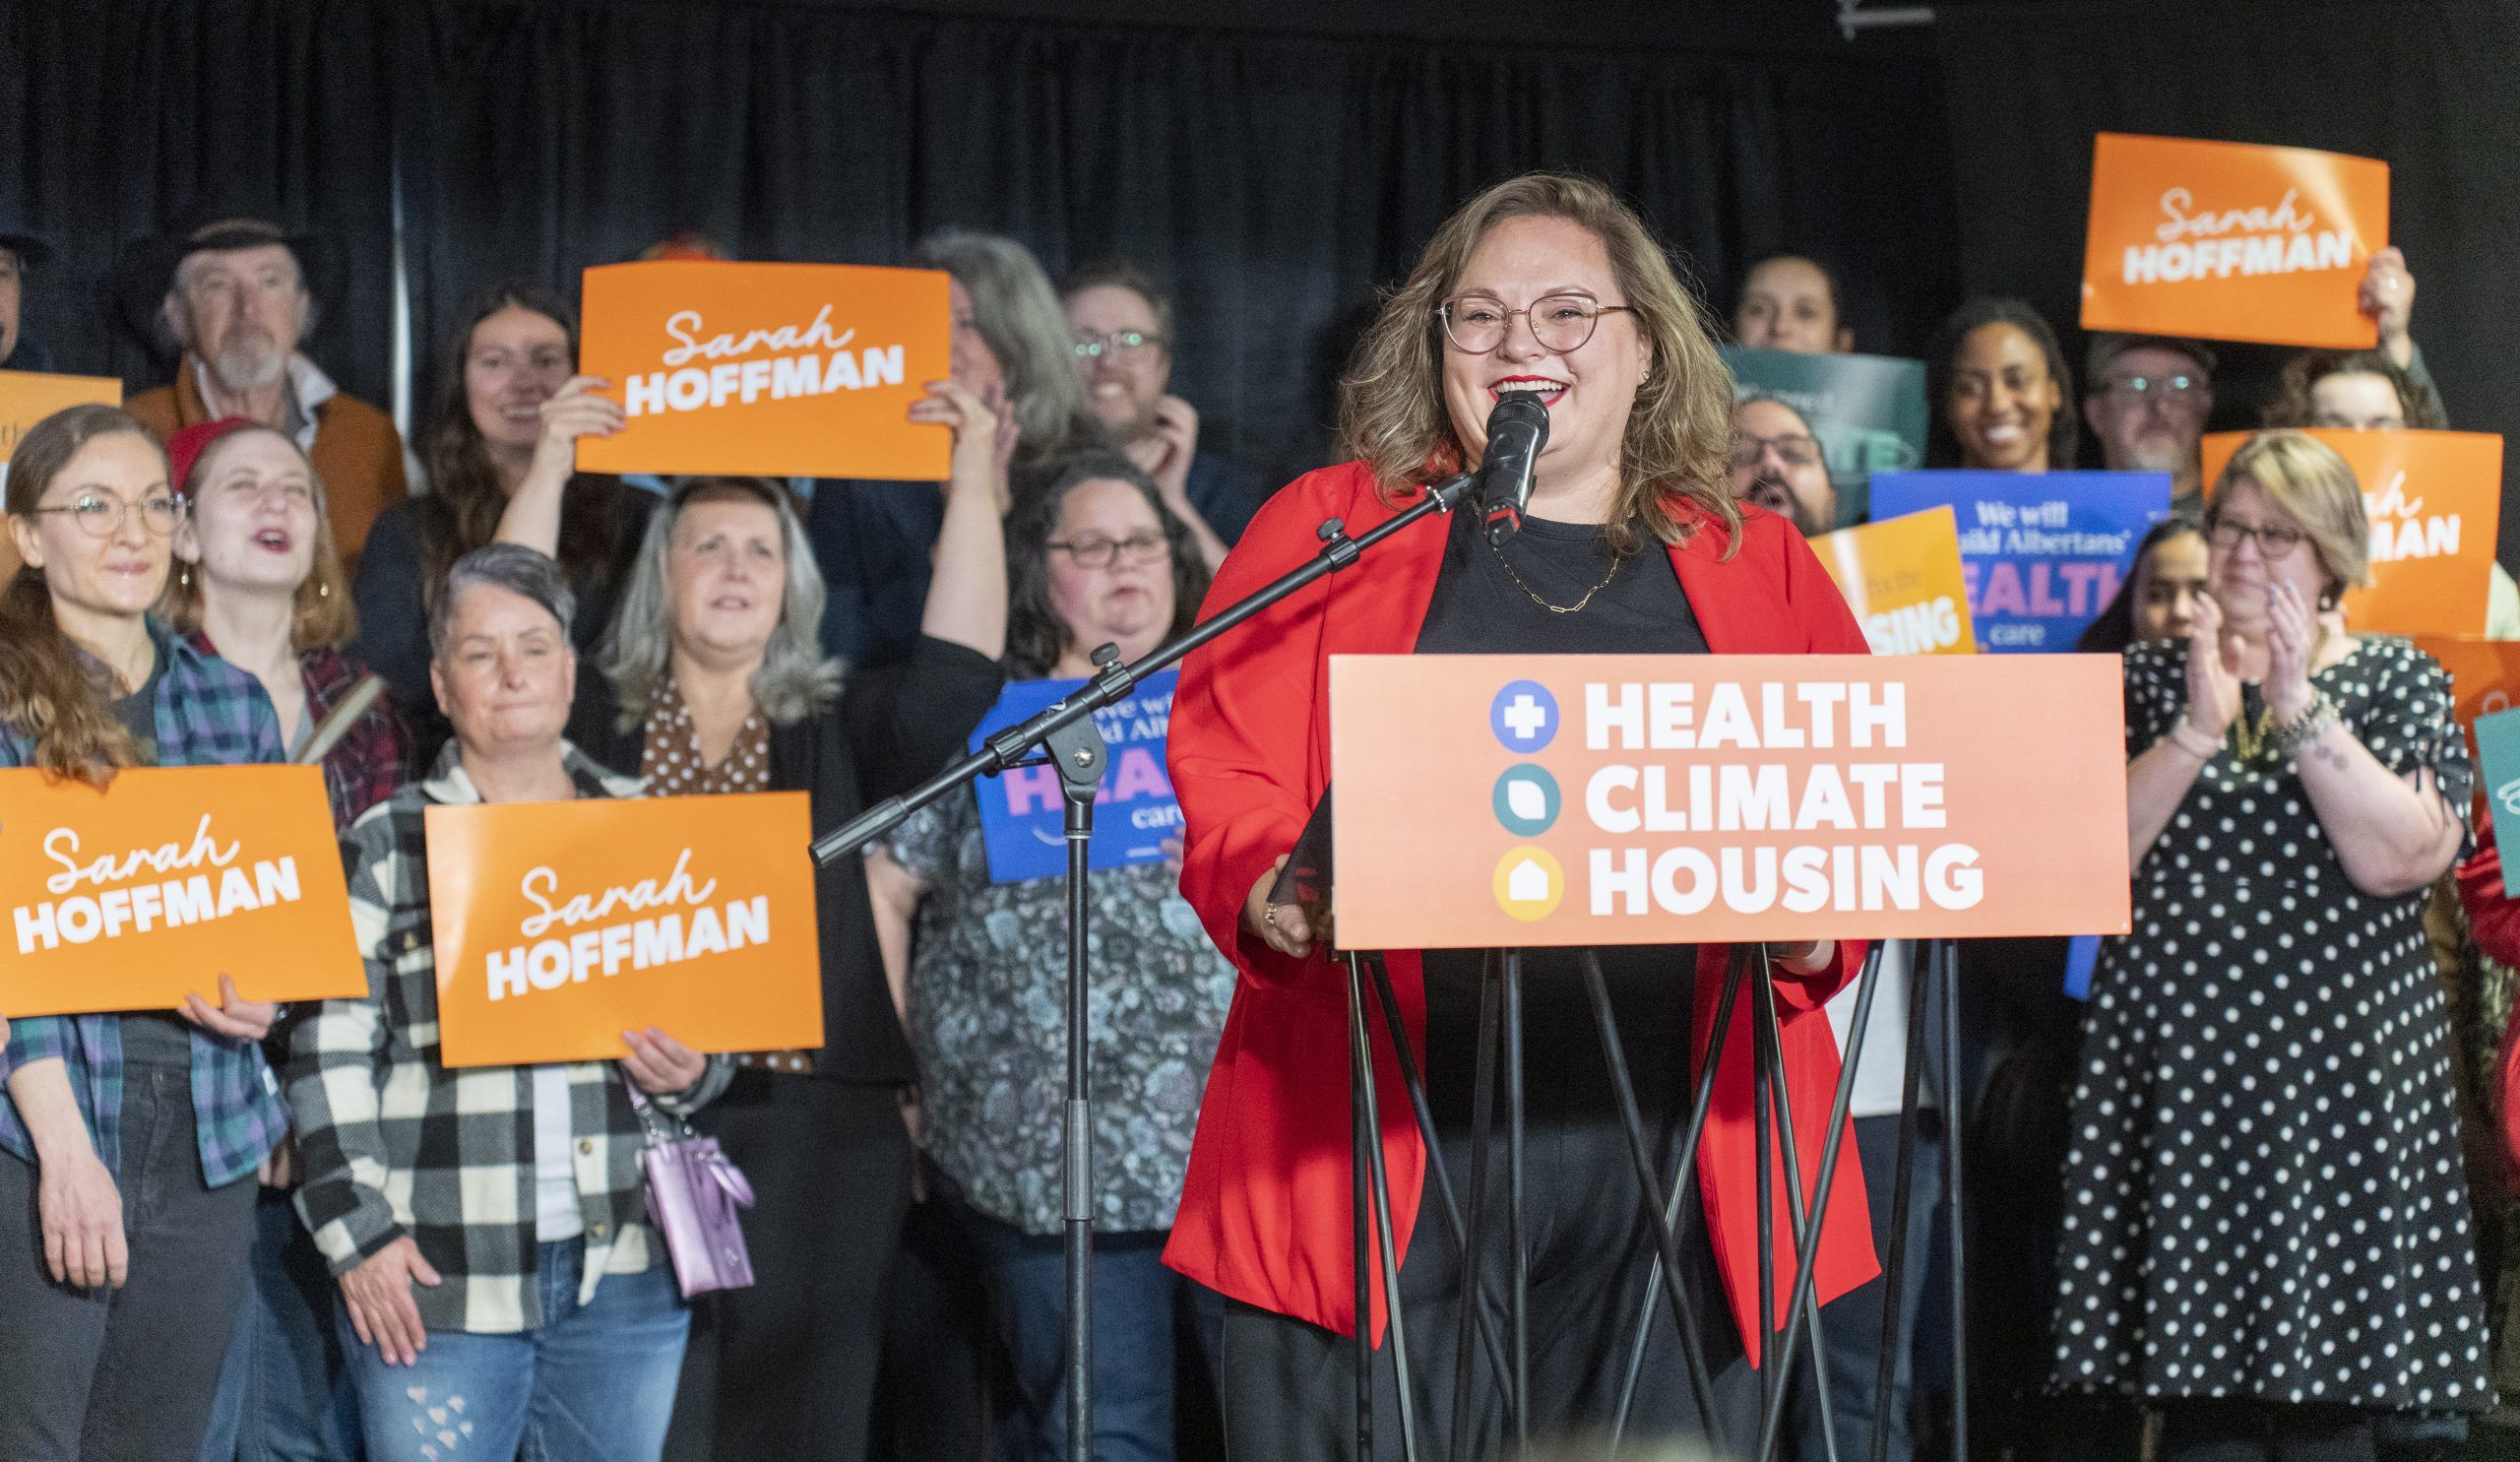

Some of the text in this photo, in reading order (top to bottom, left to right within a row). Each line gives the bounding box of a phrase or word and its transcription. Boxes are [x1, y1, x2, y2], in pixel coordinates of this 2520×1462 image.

[2156, 186, 2314, 242] Sarah
[2122, 229, 2354, 286] HOFFMAN
[662, 303, 855, 367] Sarah
[625, 345, 905, 417] HOFFMAN
[1975, 501, 2068, 528] We will
[1865, 596, 1961, 656] SING
[1988, 623, 2047, 647] care
[1585, 681, 1908, 751] HEALTH
[1130, 803, 1186, 830] car
[1585, 762, 1948, 835] CLIMATE
[43, 813, 241, 895] Sarah
[1587, 843, 1984, 917] HOUSING
[13, 856, 301, 955] HOFFMAN
[520, 847, 718, 938] Sarah
[485, 895, 771, 1002] HOFFMAN
